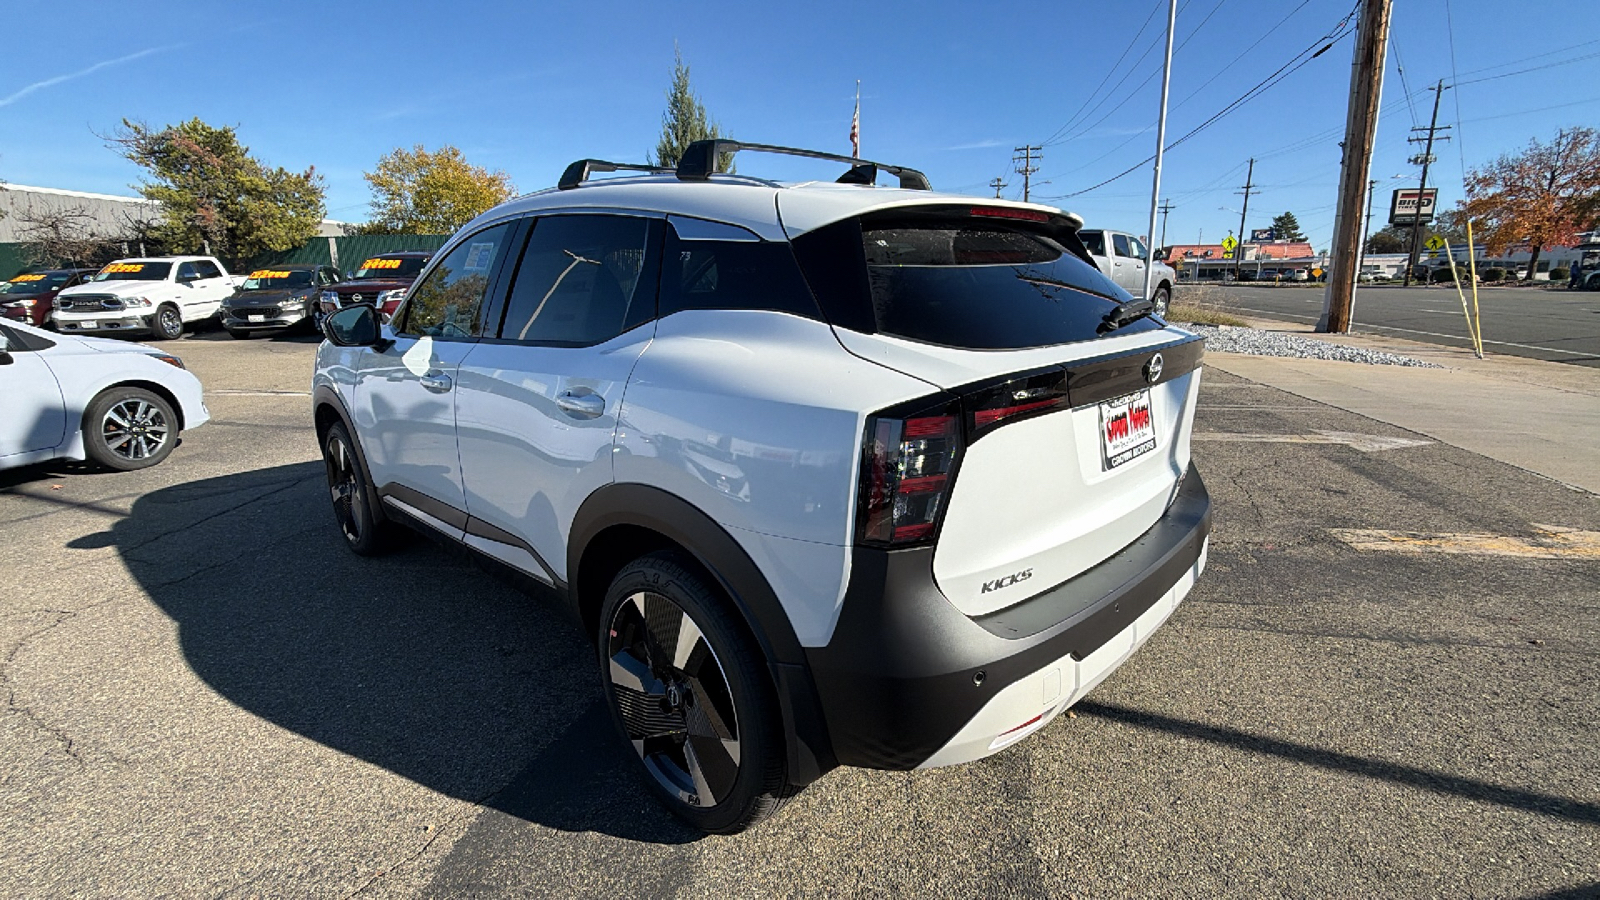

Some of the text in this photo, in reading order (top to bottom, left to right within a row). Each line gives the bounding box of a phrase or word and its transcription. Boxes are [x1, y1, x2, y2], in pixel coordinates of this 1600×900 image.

[1111, 450, 1133, 467] CROWN
[1132, 440, 1155, 458] MOTORS
[981, 567, 1033, 594] KICKS
